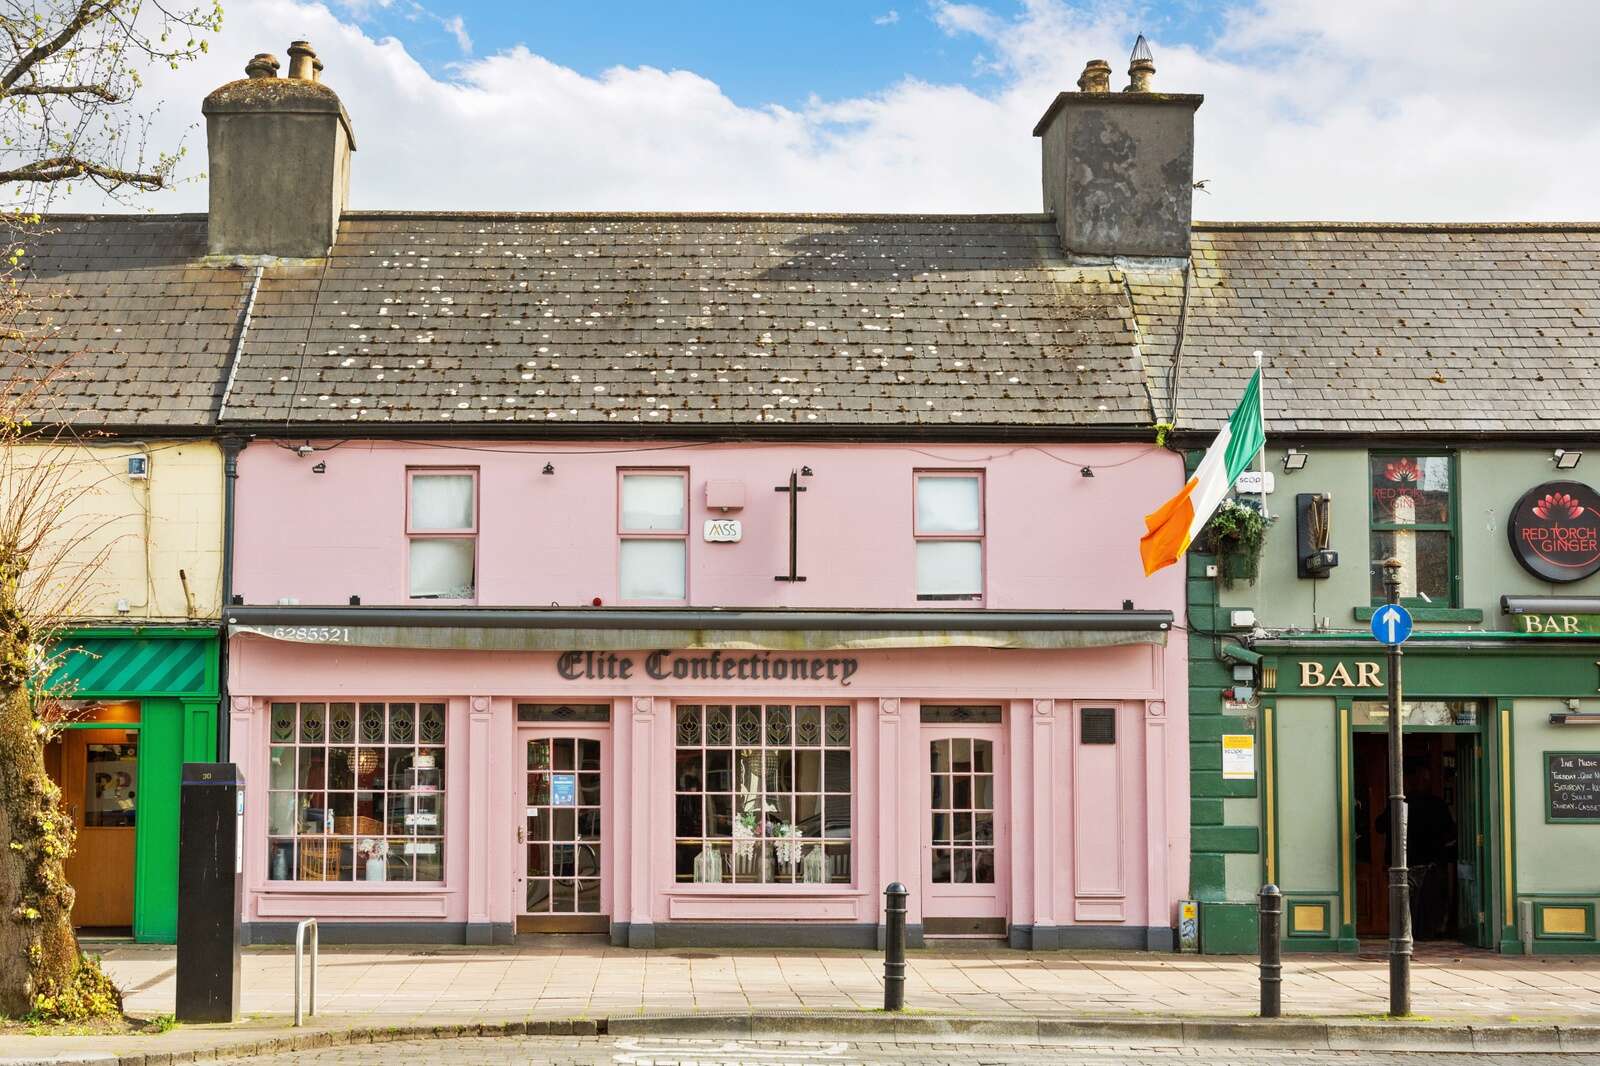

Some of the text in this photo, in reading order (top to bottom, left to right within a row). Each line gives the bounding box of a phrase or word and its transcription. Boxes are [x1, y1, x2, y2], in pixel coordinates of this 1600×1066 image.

[709, 523, 737, 536] MSS
[1522, 527, 1597, 540] RED TORCH
[1541, 539, 1598, 552] GINGER
[1522, 614, 1584, 633] BAR
[556, 650, 858, 687] Elite Confectionery
[1298, 661, 1385, 688] BAR
